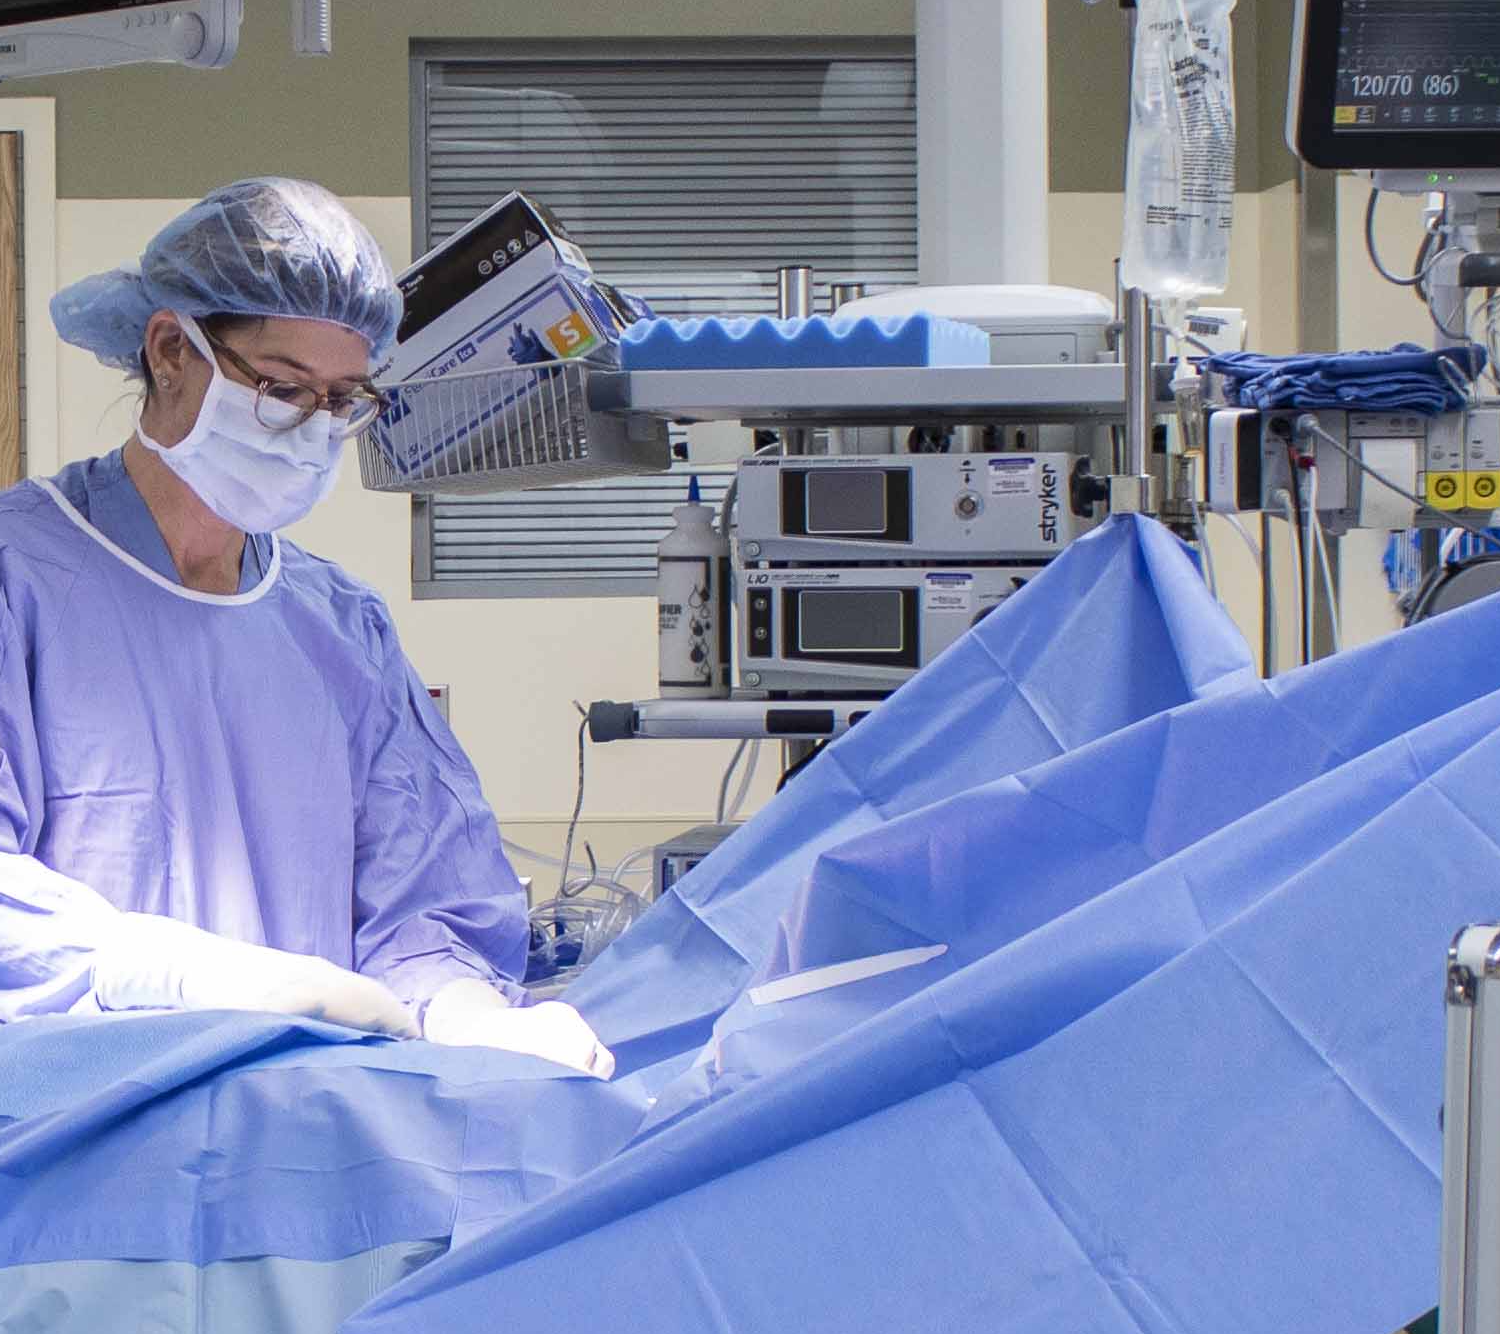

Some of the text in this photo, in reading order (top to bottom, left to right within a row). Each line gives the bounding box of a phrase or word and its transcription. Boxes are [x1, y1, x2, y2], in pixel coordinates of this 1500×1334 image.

[1351, 73, 1460, 97] 120/70 (86)
[558, 319, 581, 346] S
[1037, 463, 1060, 544] stryker
